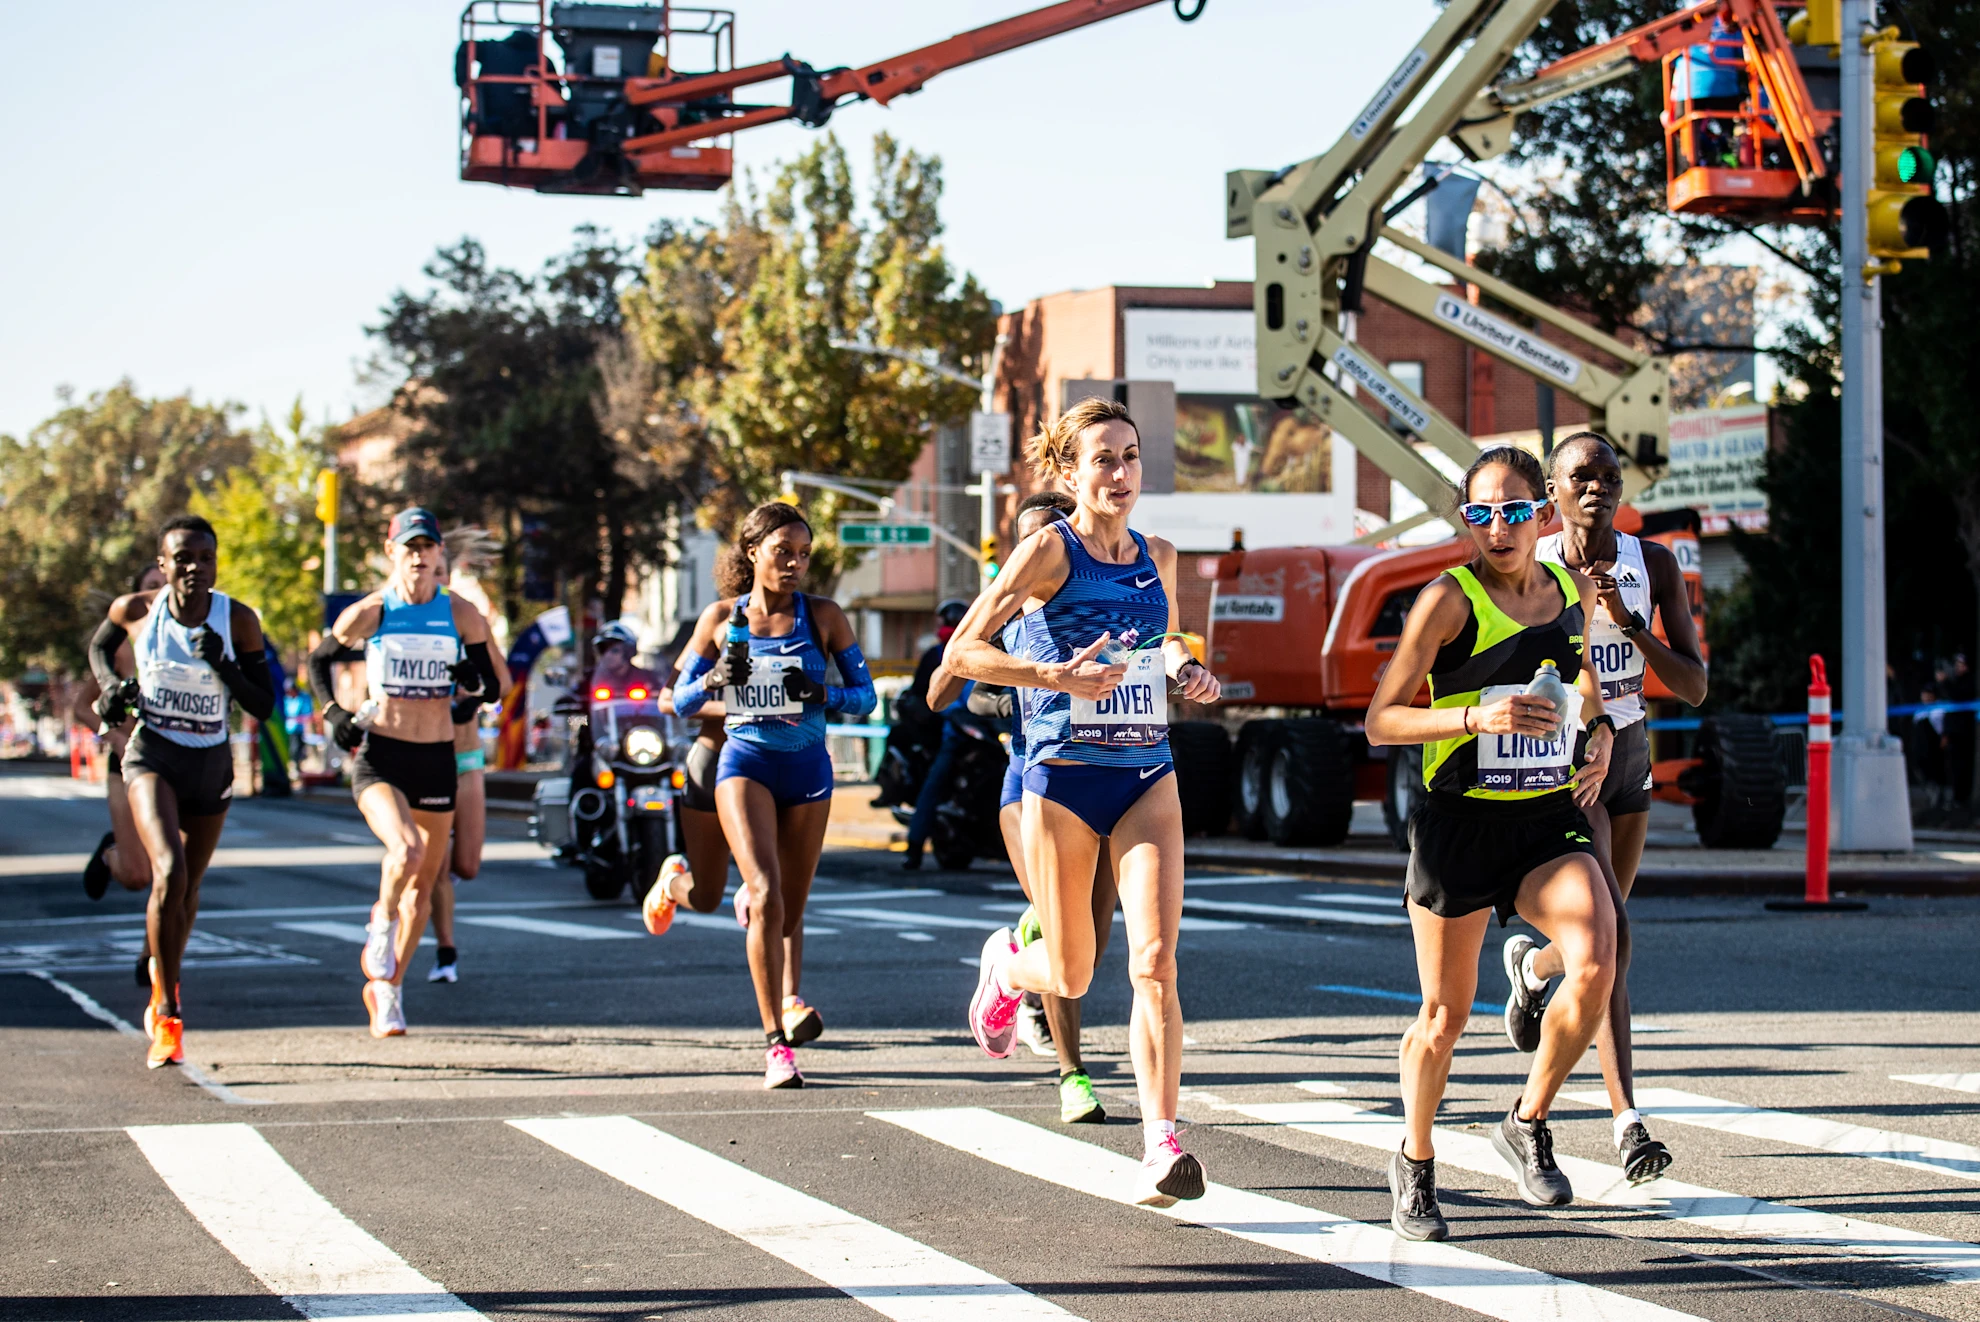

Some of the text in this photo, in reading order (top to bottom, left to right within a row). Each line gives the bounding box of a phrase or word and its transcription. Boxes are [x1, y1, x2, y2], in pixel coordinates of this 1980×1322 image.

[1365, 55, 1422, 122] United Rentals
[1146, 333, 1201, 348] Millions
[1206, 334, 1221, 348] of
[1463, 311, 1570, 375] United Rentals
[1147, 354, 1182, 372] Only
[1187, 358, 1214, 369] one
[1219, 355, 1242, 369] like
[979, 438, 1003, 455] 25
[1616, 581, 1641, 589] adidas
[1230, 600, 1275, 617] Rentals
[1590, 641, 1633, 674] ROP
[390, 657, 448, 681] TAYLOR
[734, 684, 786, 708] NGUGI
[1077, 729, 1102, 737] 2019
[1485, 774, 1512, 784] 2019
